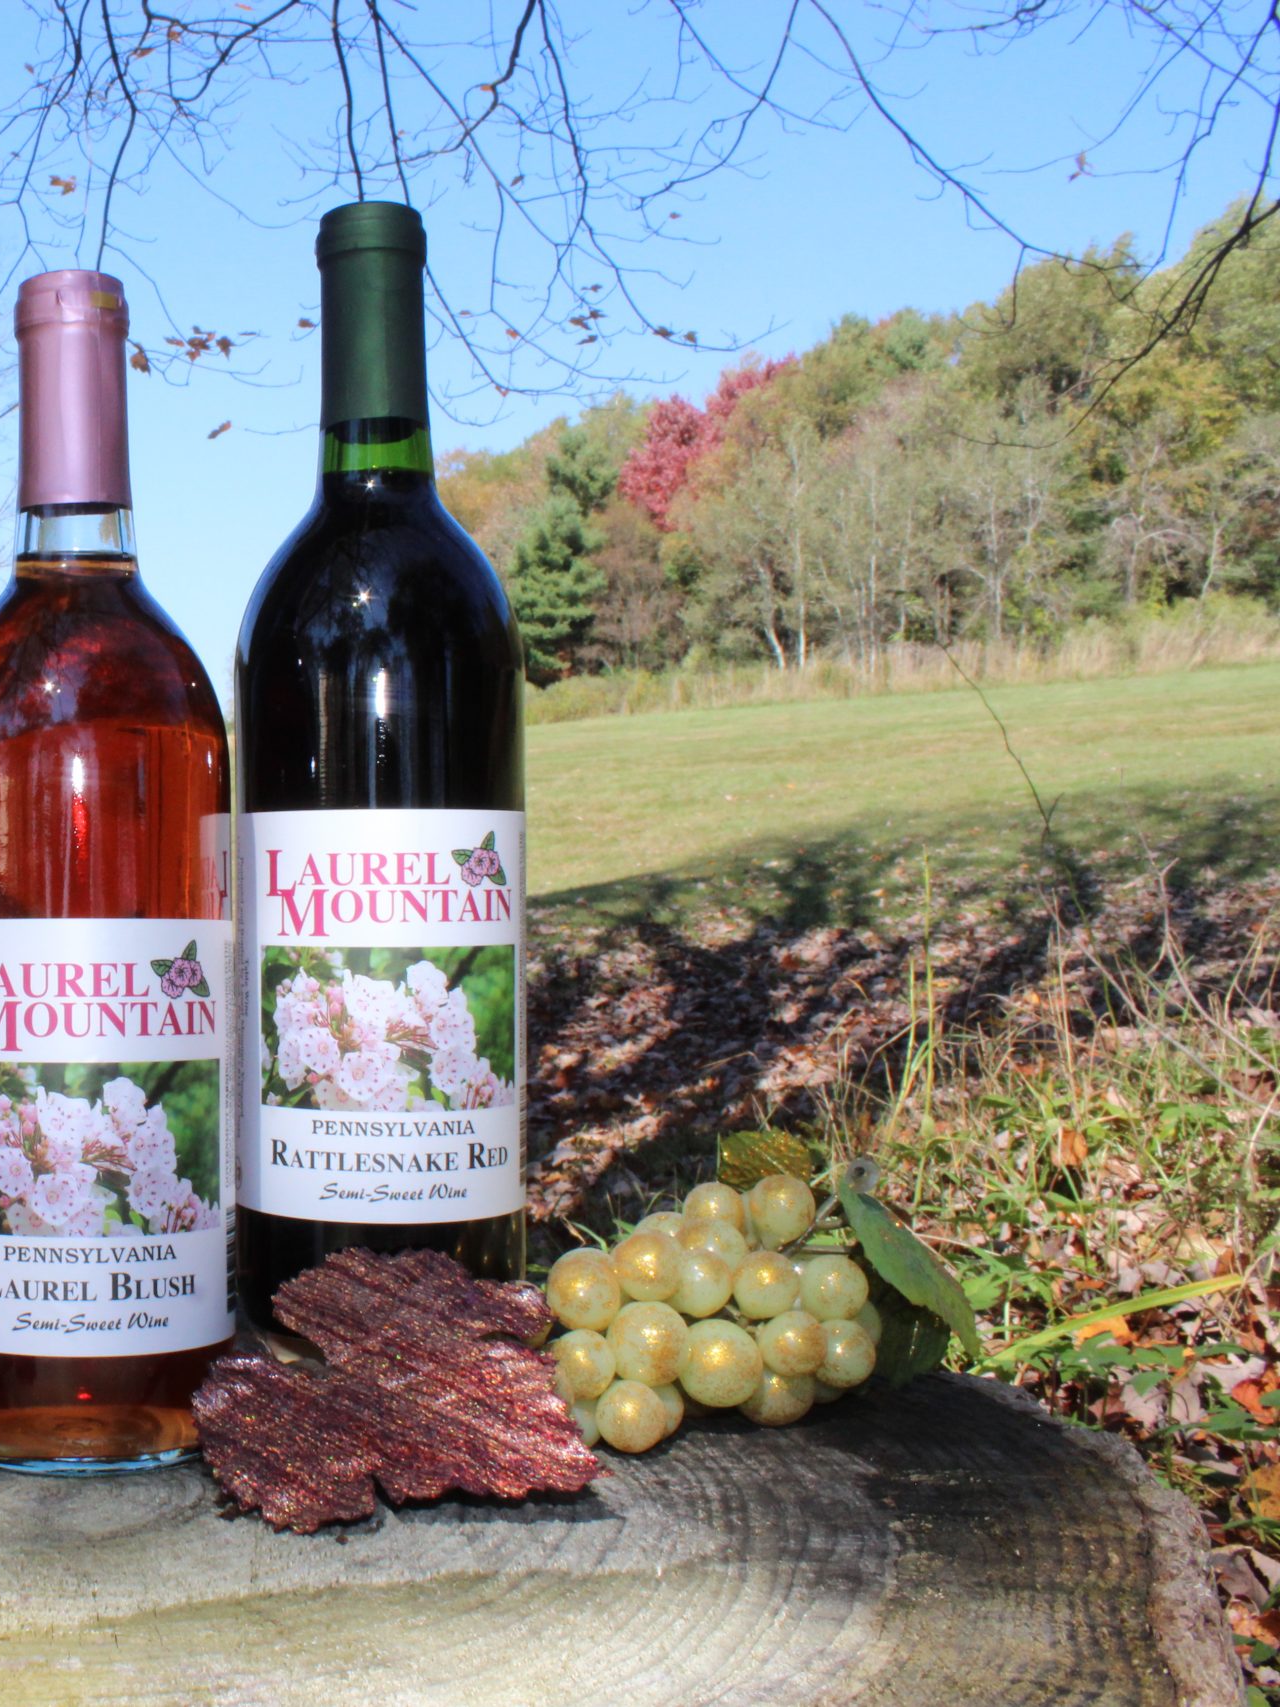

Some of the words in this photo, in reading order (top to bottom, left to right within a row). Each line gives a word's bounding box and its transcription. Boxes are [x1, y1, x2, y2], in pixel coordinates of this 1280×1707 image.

[266, 849, 450, 897] LAUREL
[277, 889, 512, 937] MOUNTAIN
[312, 1120, 475, 1137] PENNSYLVANIA
[272, 1139, 458, 1173] RATTLESNAKE
[468, 1142, 508, 1169] RED
[320, 1183, 423, 1202] Semi-Sweet
[429, 1184, 466, 1199] Wine
[4, 1244, 177, 1264] PENNSYLVANIA
[110, 1272, 196, 1301] BLUSH
[12, 1313, 121, 1333] Semi-Sweet
[128, 1313, 168, 1328] Wine
